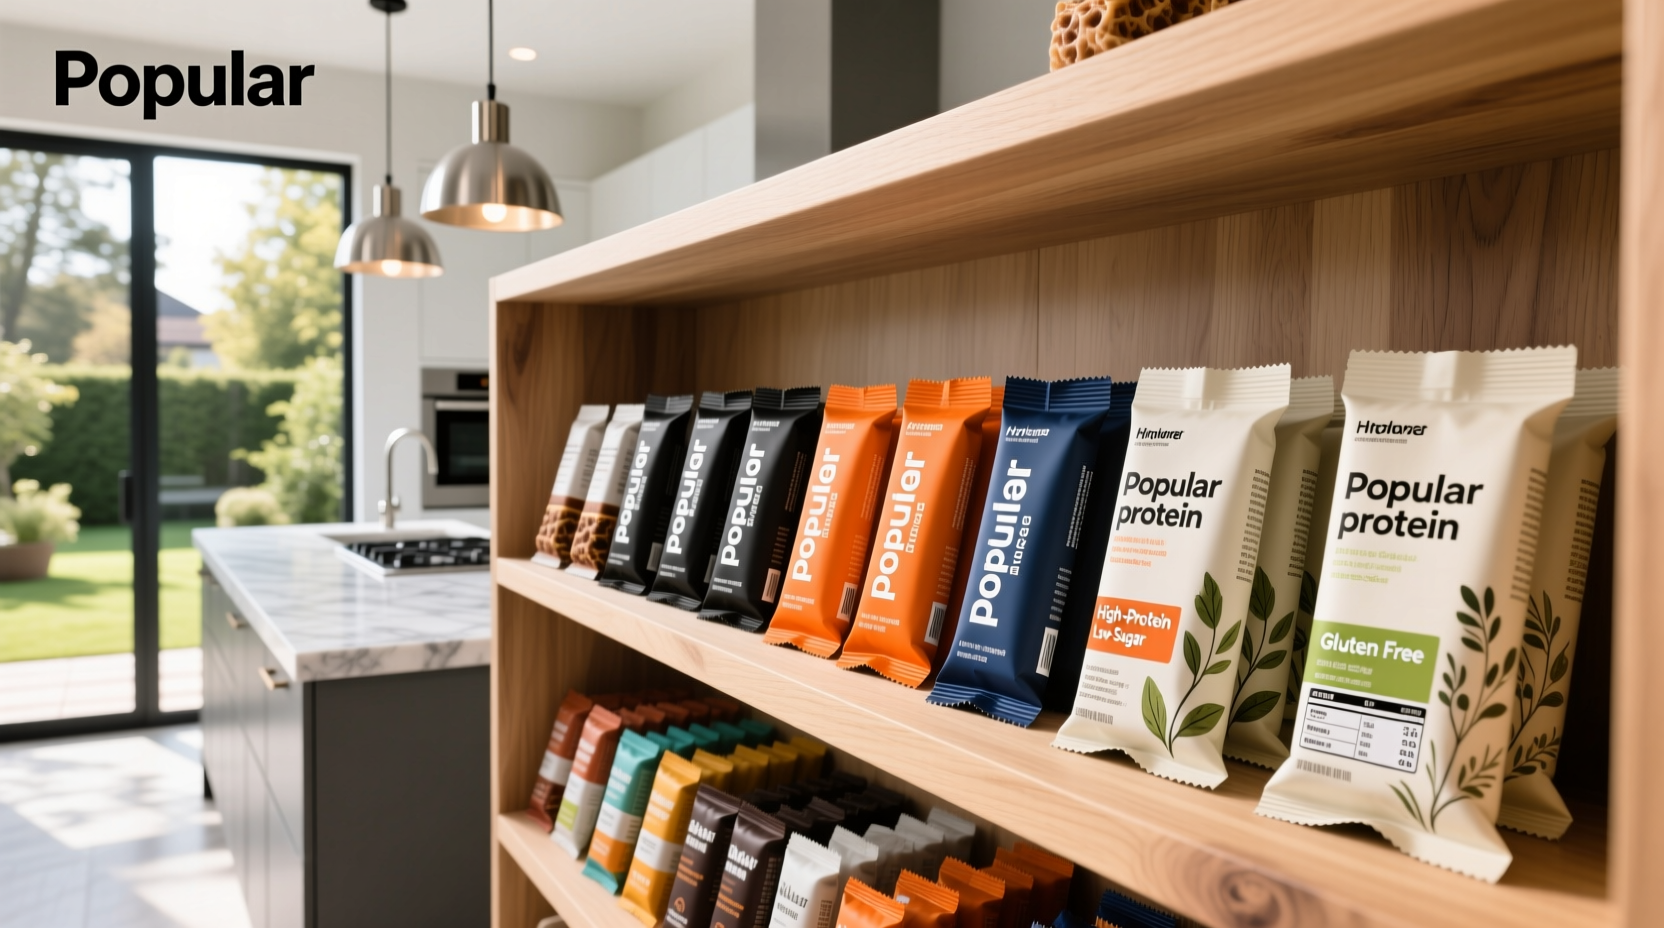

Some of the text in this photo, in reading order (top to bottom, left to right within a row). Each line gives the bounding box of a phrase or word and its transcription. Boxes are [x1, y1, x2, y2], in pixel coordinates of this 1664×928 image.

[1123, 471, 1223, 503] Popular
[1345, 471, 1484, 509] Popular
[1115, 502, 1203, 531] protein
[1337, 509, 1459, 540] protein
[1113, 626, 1147, 648] Sugar
[1320, 632, 1425, 664] Gluten Free
